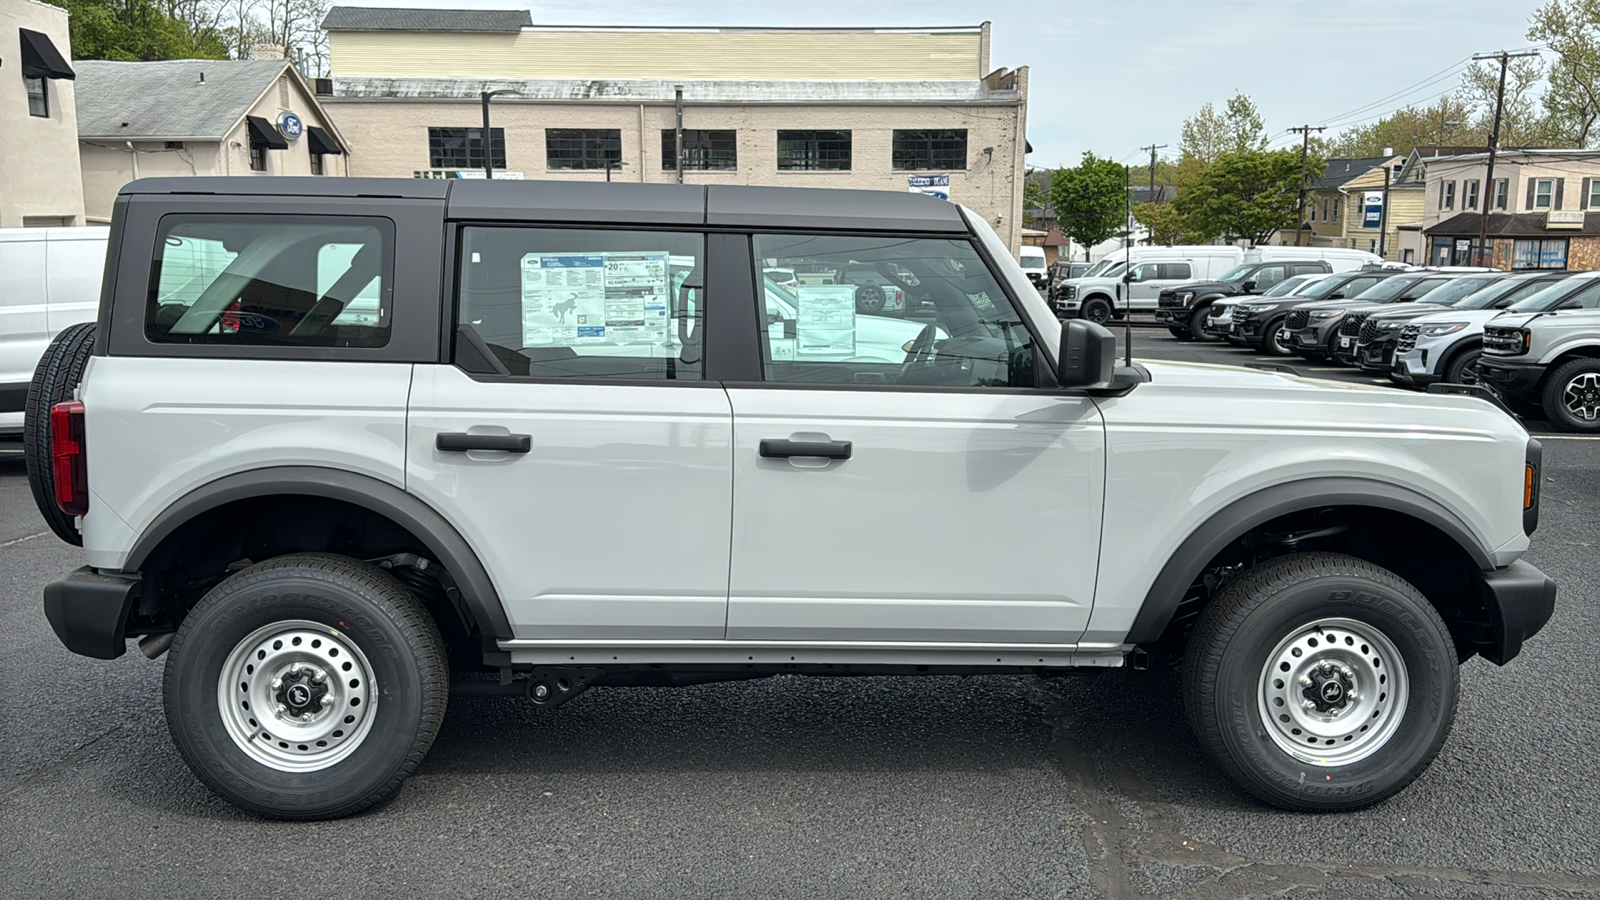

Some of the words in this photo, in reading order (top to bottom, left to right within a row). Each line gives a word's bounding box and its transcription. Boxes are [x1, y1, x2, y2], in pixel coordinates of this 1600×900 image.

[287, 117, 300, 134] Ford
[608, 262, 619, 271] 20
[210, 592, 398, 660] BRIDGESTONE
[1327, 589, 1441, 674] DUELER
[1231, 688, 1375, 799] BRIDGESTONE
